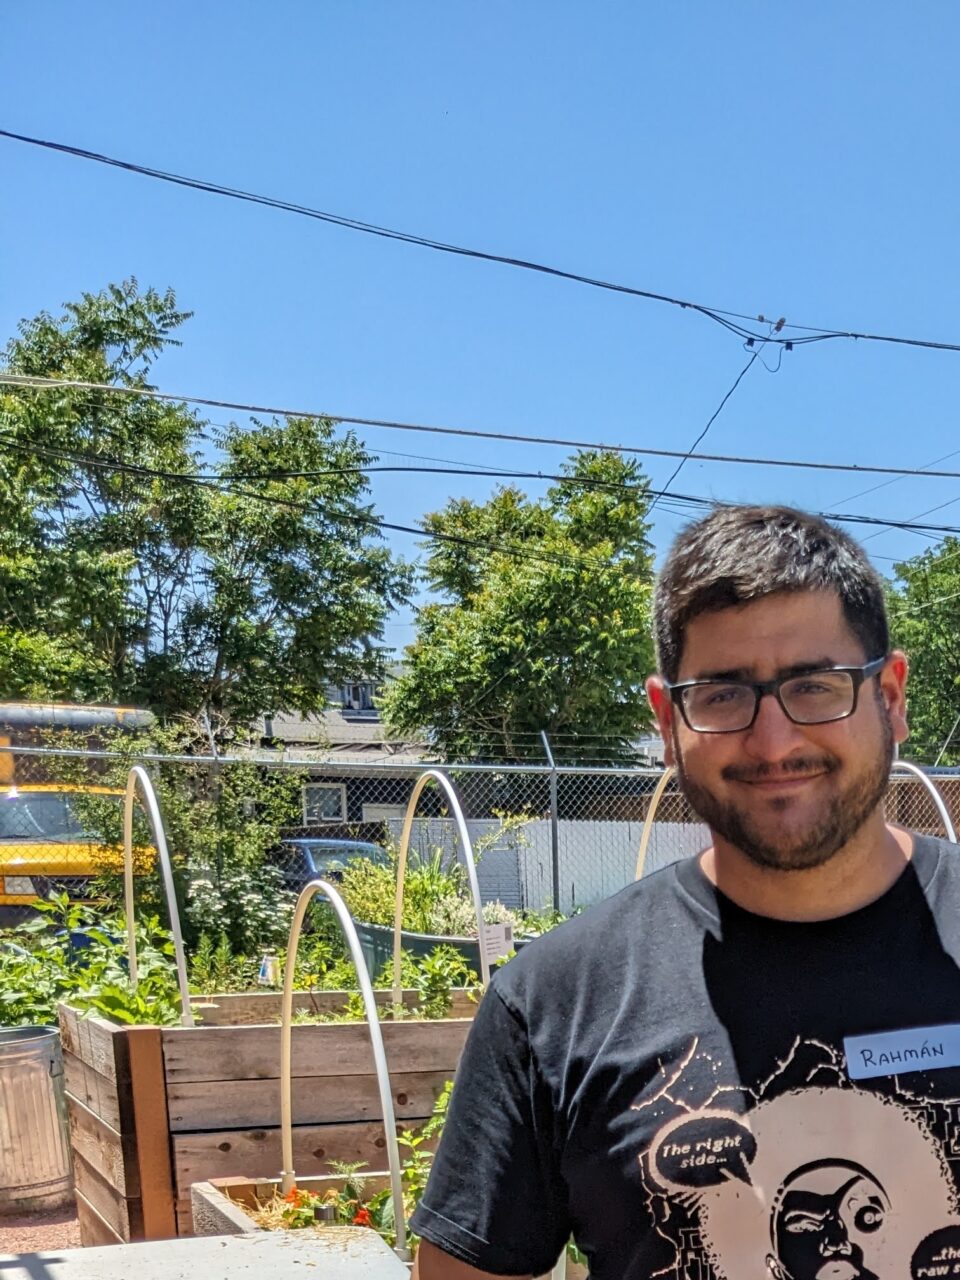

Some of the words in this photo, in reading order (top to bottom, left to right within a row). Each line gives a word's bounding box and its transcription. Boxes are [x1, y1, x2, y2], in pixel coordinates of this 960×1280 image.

[860, 1041, 944, 1067] RAHMÁN
[662, 1143, 691, 1158] The
[696, 1135, 742, 1152] right
[680, 1153, 727, 1169] side...
[917, 1266, 950, 1278] raw
